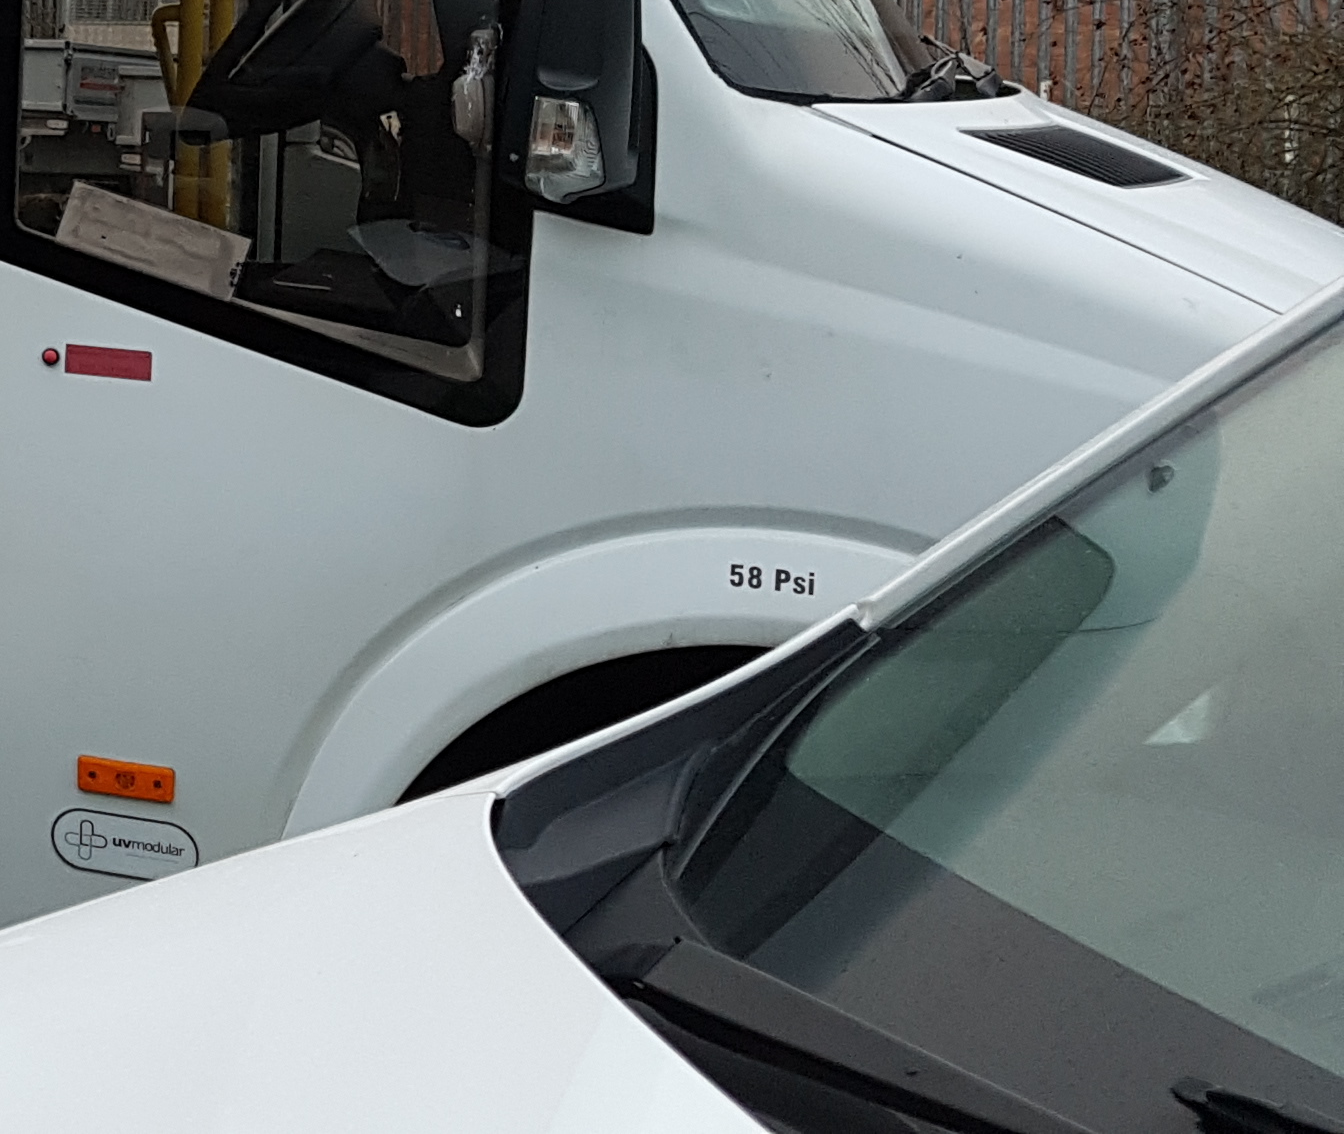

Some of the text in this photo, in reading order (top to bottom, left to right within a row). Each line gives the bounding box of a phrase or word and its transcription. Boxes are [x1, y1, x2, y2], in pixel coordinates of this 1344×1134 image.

[729, 563, 815, 596] 58 Psi
[112, 837, 186, 857] uvmodular
